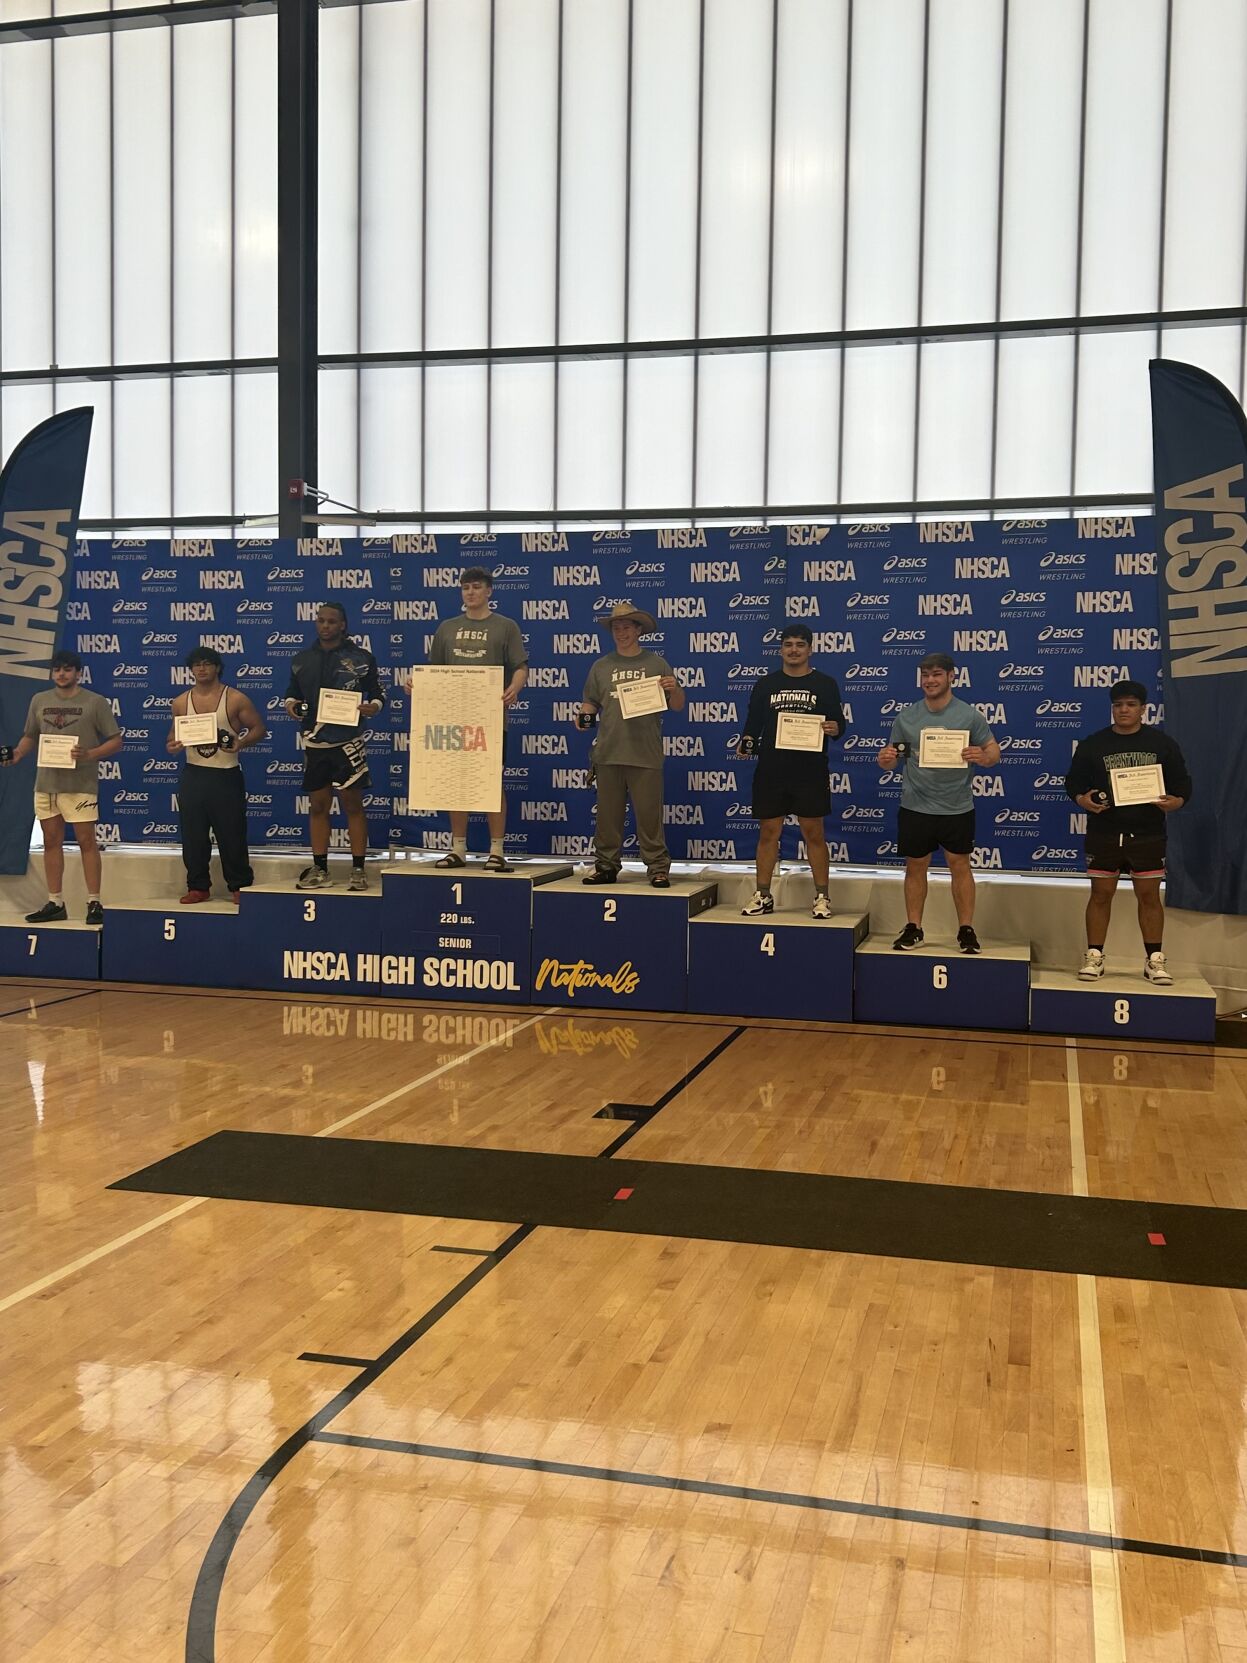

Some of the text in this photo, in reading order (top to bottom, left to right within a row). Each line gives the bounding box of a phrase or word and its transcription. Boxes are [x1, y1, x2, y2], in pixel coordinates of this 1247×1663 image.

[920, 522, 974, 543] NHSCA
[729, 542, 771, 550] WRESTLING
[848, 541, 891, 549] WRESTLING
[898, 558, 927, 568] asics
[1055, 554, 1086, 564] asics
[504, 566, 529, 575] asics
[639, 563, 665, 572] asics
[690, 561, 740, 583] NHSCA
[804, 561, 856, 582] NHSCA
[955, 557, 1010, 579] NHSCA
[1164, 464, 1247, 678] NHSCA
[153, 570, 177, 579] asics
[279, 569, 304, 578] asics
[327, 569, 372, 588] NHSCA
[553, 566, 601, 586] NHSCA
[76, 571, 119, 589] NHSCA
[200, 571, 244, 589] NHSCA
[625, 580, 665, 588] WRESTLING
[883, 576, 927, 584] WRESTLING
[0, 508, 72, 681] NHSCA
[742, 595, 770, 605] asics
[860, 595, 889, 605] asics
[1016, 592, 1046, 602] asics
[124, 602, 147, 611] asics
[248, 602, 273, 611] asics
[658, 597, 707, 618] NHSCA
[918, 594, 972, 615] NHSCA
[1076, 591, 1133, 613] NHSCA
[170, 602, 214, 621] NHSCA
[394, 601, 438, 620] NHSCA
[523, 600, 569, 620] NHSCA
[154, 633, 177, 642] asics
[279, 634, 303, 643] asics
[897, 630, 926, 640] asics
[1053, 628, 1084, 638] asics
[77, 635, 120, 653] NHSCA
[553, 634, 600, 653] NHSCA
[689, 632, 739, 653] NHSCA
[954, 630, 1008, 651] NHSCA
[124, 665, 148, 675] asics
[248, 666, 272, 675] asics
[741, 666, 768, 676] asics
[859, 666, 888, 676] asics
[1014, 666, 1044, 675] asics
[770, 693, 817, 704] NATIONALS
[689, 702, 738, 722] NHSCA
[1051, 702, 1082, 712] asics
[124, 729, 148, 738] asics
[425, 725, 487, 751] NHSCA
[522, 735, 568, 754] NHSCA
[857, 738, 886, 747] asics
[1012, 739, 1042, 748] asics
[155, 761, 178, 769] asics
[279, 763, 302, 772] asics
[504, 767, 528, 776] asics
[688, 771, 737, 792] NHSCA
[125, 793, 148, 801] asics
[248, 795, 272, 803] asics
[521, 801, 567, 821] NHSCA
[856, 808, 884, 818] asics
[1009, 812, 1040, 821] asics
[95, 824, 121, 842] SCA
[155, 824, 178, 833] asics
[278, 827, 302, 836] asics
[504, 833, 527, 842] asics
[687, 840, 736, 859] NHSCA
[1047, 849, 1077, 859] asics
[971, 847, 1002, 868] SCA
[451, 883, 462, 904] 1
[304, 900, 316, 921] 3
[604, 899, 616, 921] 2
[440, 913, 474, 924] 220 LBS.
[164, 919, 176, 940] 5
[28, 935, 37, 955] 7
[439, 937, 472, 949] SENIOR
[760, 934, 775, 956] 4
[283, 951, 520, 991] NHSCA HIGH SCHOOL
[535, 958, 640, 997] Nationals
[933, 965, 948, 989] 6
[1114, 1000, 1130, 1024] 8
